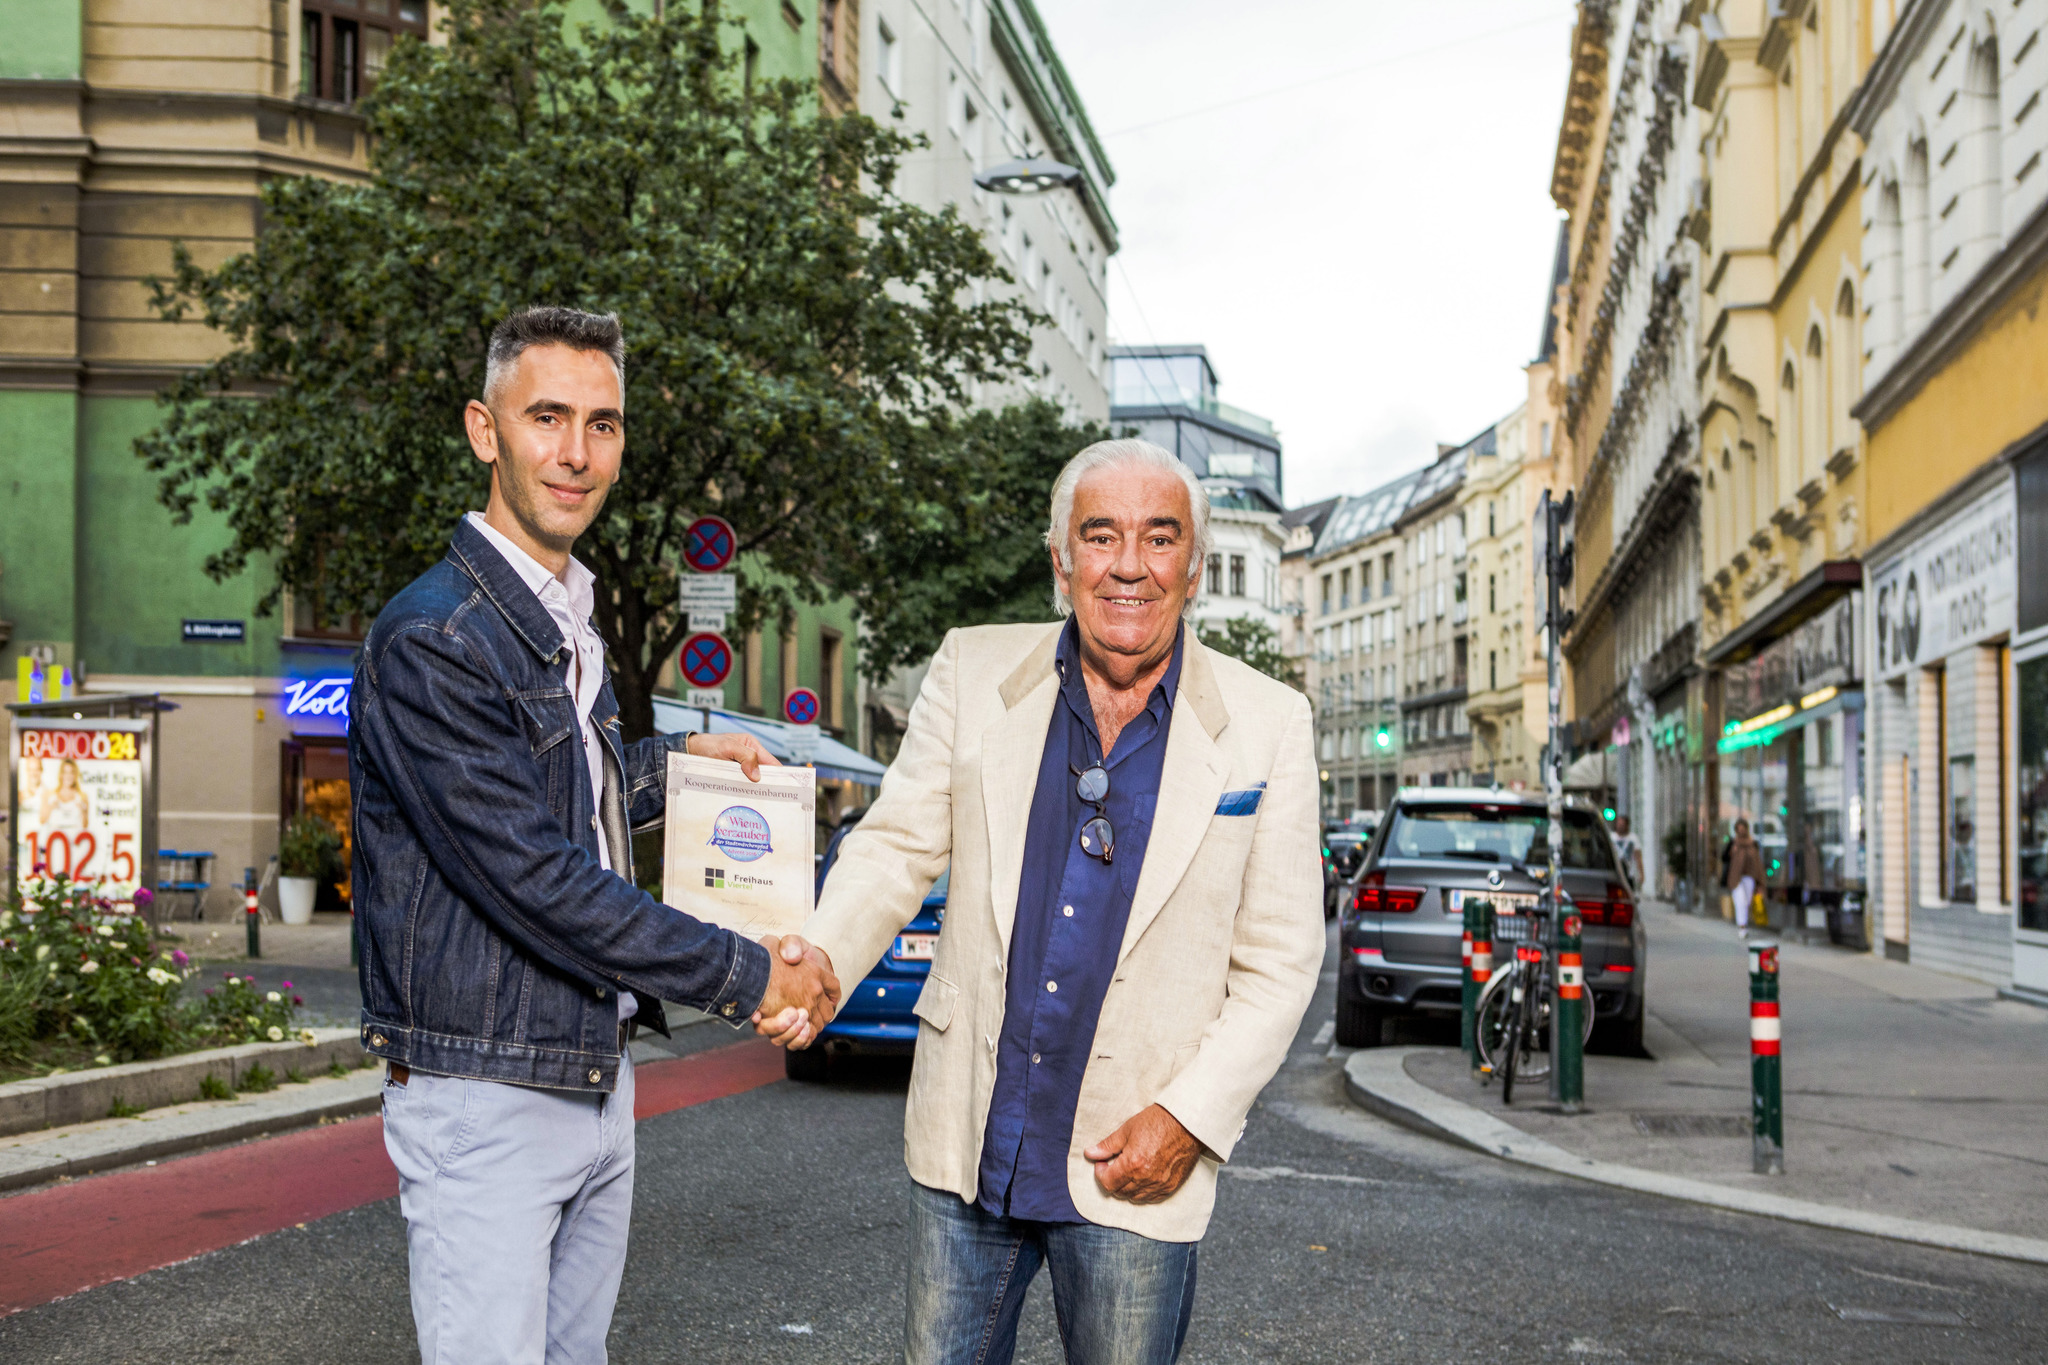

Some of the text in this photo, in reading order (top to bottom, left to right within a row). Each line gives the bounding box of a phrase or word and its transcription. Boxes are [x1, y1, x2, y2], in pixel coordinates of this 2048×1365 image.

[684, 777, 799, 800] Kooperationsvereinbarung
[716, 828, 769, 842] verzaubert
[25, 831, 136, 883] 102.5
[727, 881, 753, 890] Viertel
[734, 874, 774, 886] Freihaus
